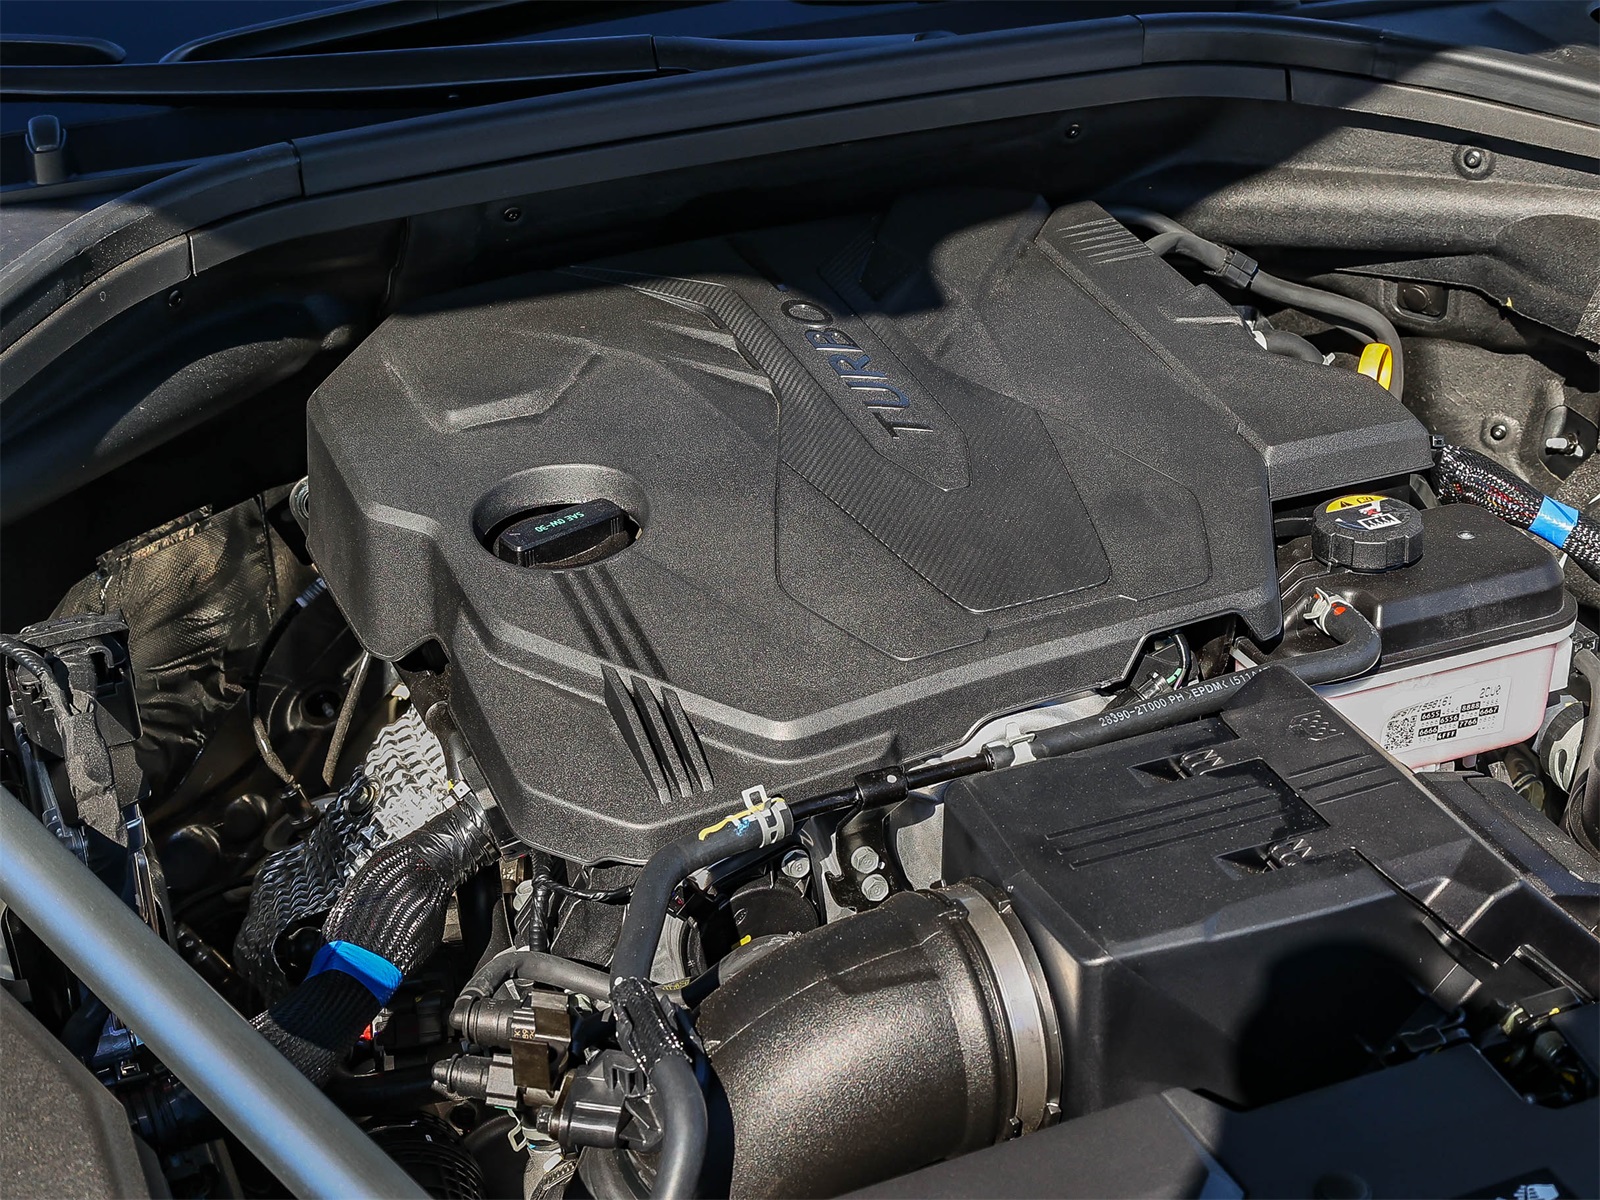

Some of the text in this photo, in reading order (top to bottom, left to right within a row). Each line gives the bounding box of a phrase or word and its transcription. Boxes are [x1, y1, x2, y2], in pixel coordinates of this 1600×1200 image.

[780, 299, 934, 440] TURBO
[534, 511, 585, 533] SAE 0W-30
[1098, 698, 1167, 727] 28390-2T000
[1167, 692, 1185, 705] PH
